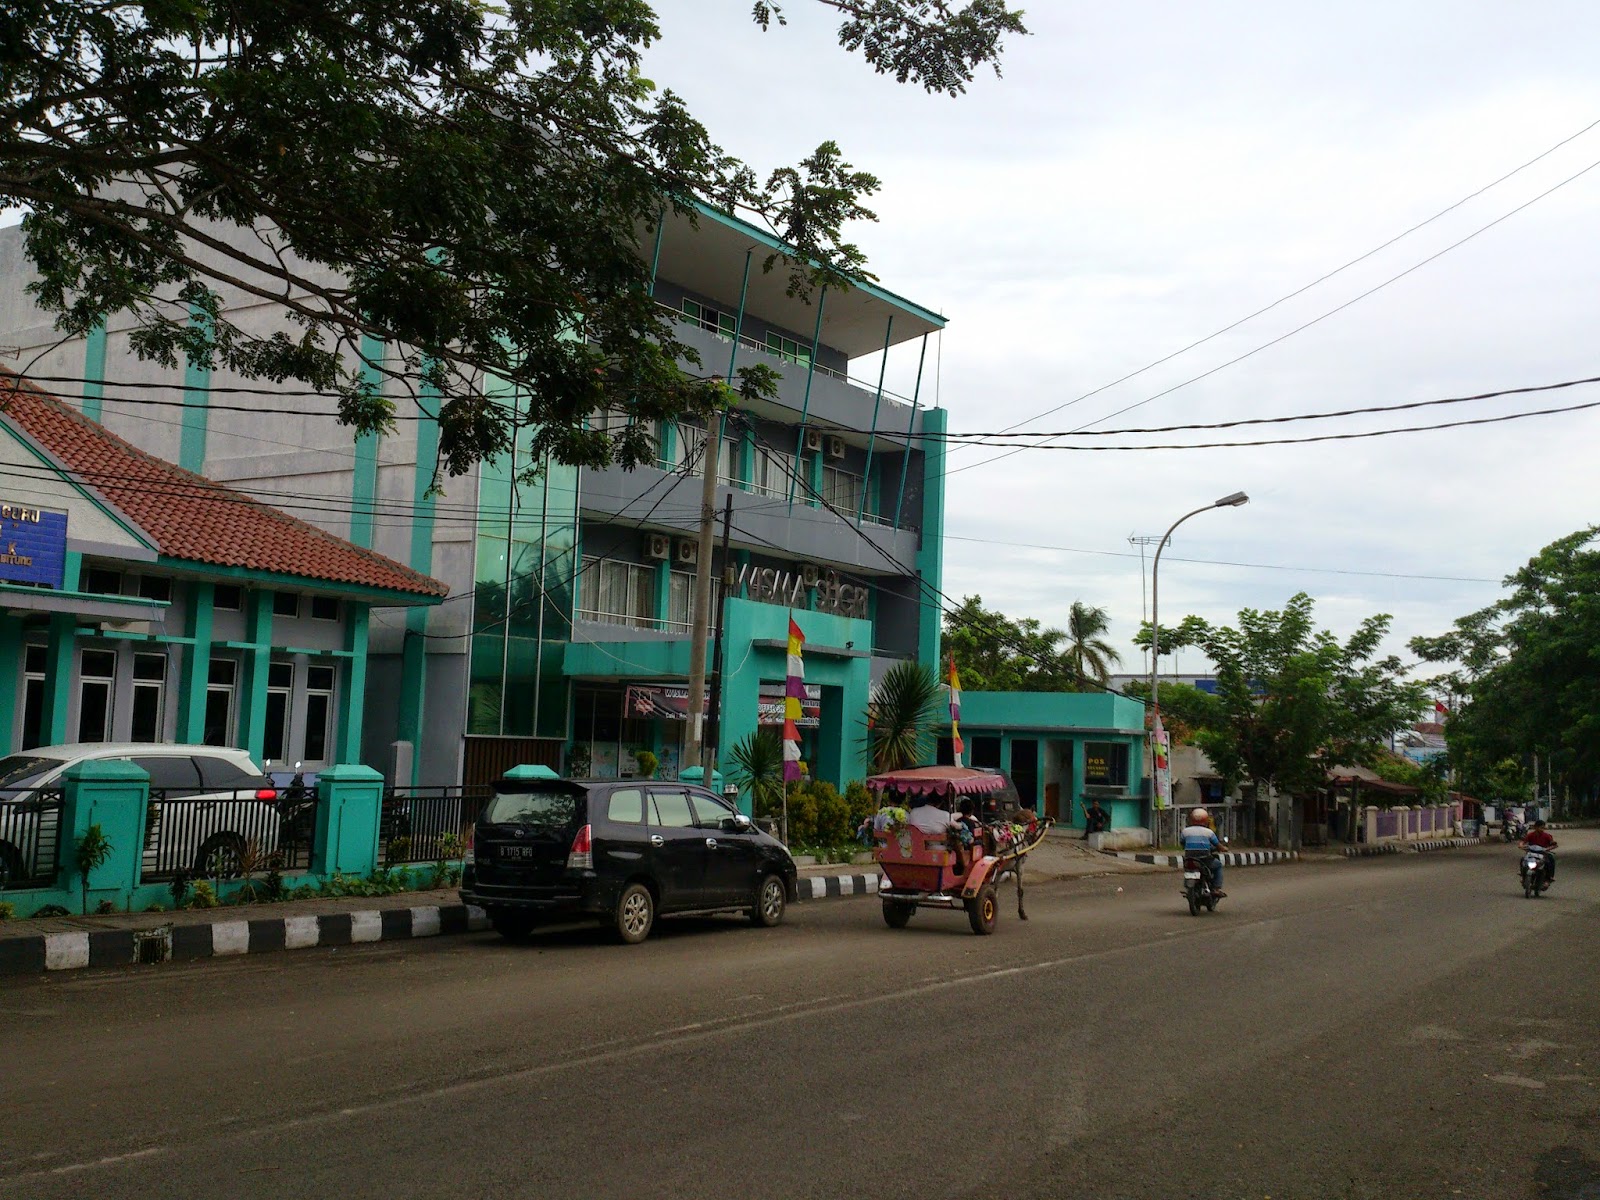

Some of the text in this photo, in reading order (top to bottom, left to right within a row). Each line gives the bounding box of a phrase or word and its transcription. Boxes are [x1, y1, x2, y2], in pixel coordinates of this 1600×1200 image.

[2, 504, 40, 523] GURU
[730, 561, 808, 609] WISMA
[1088, 757, 1105, 765] POS
